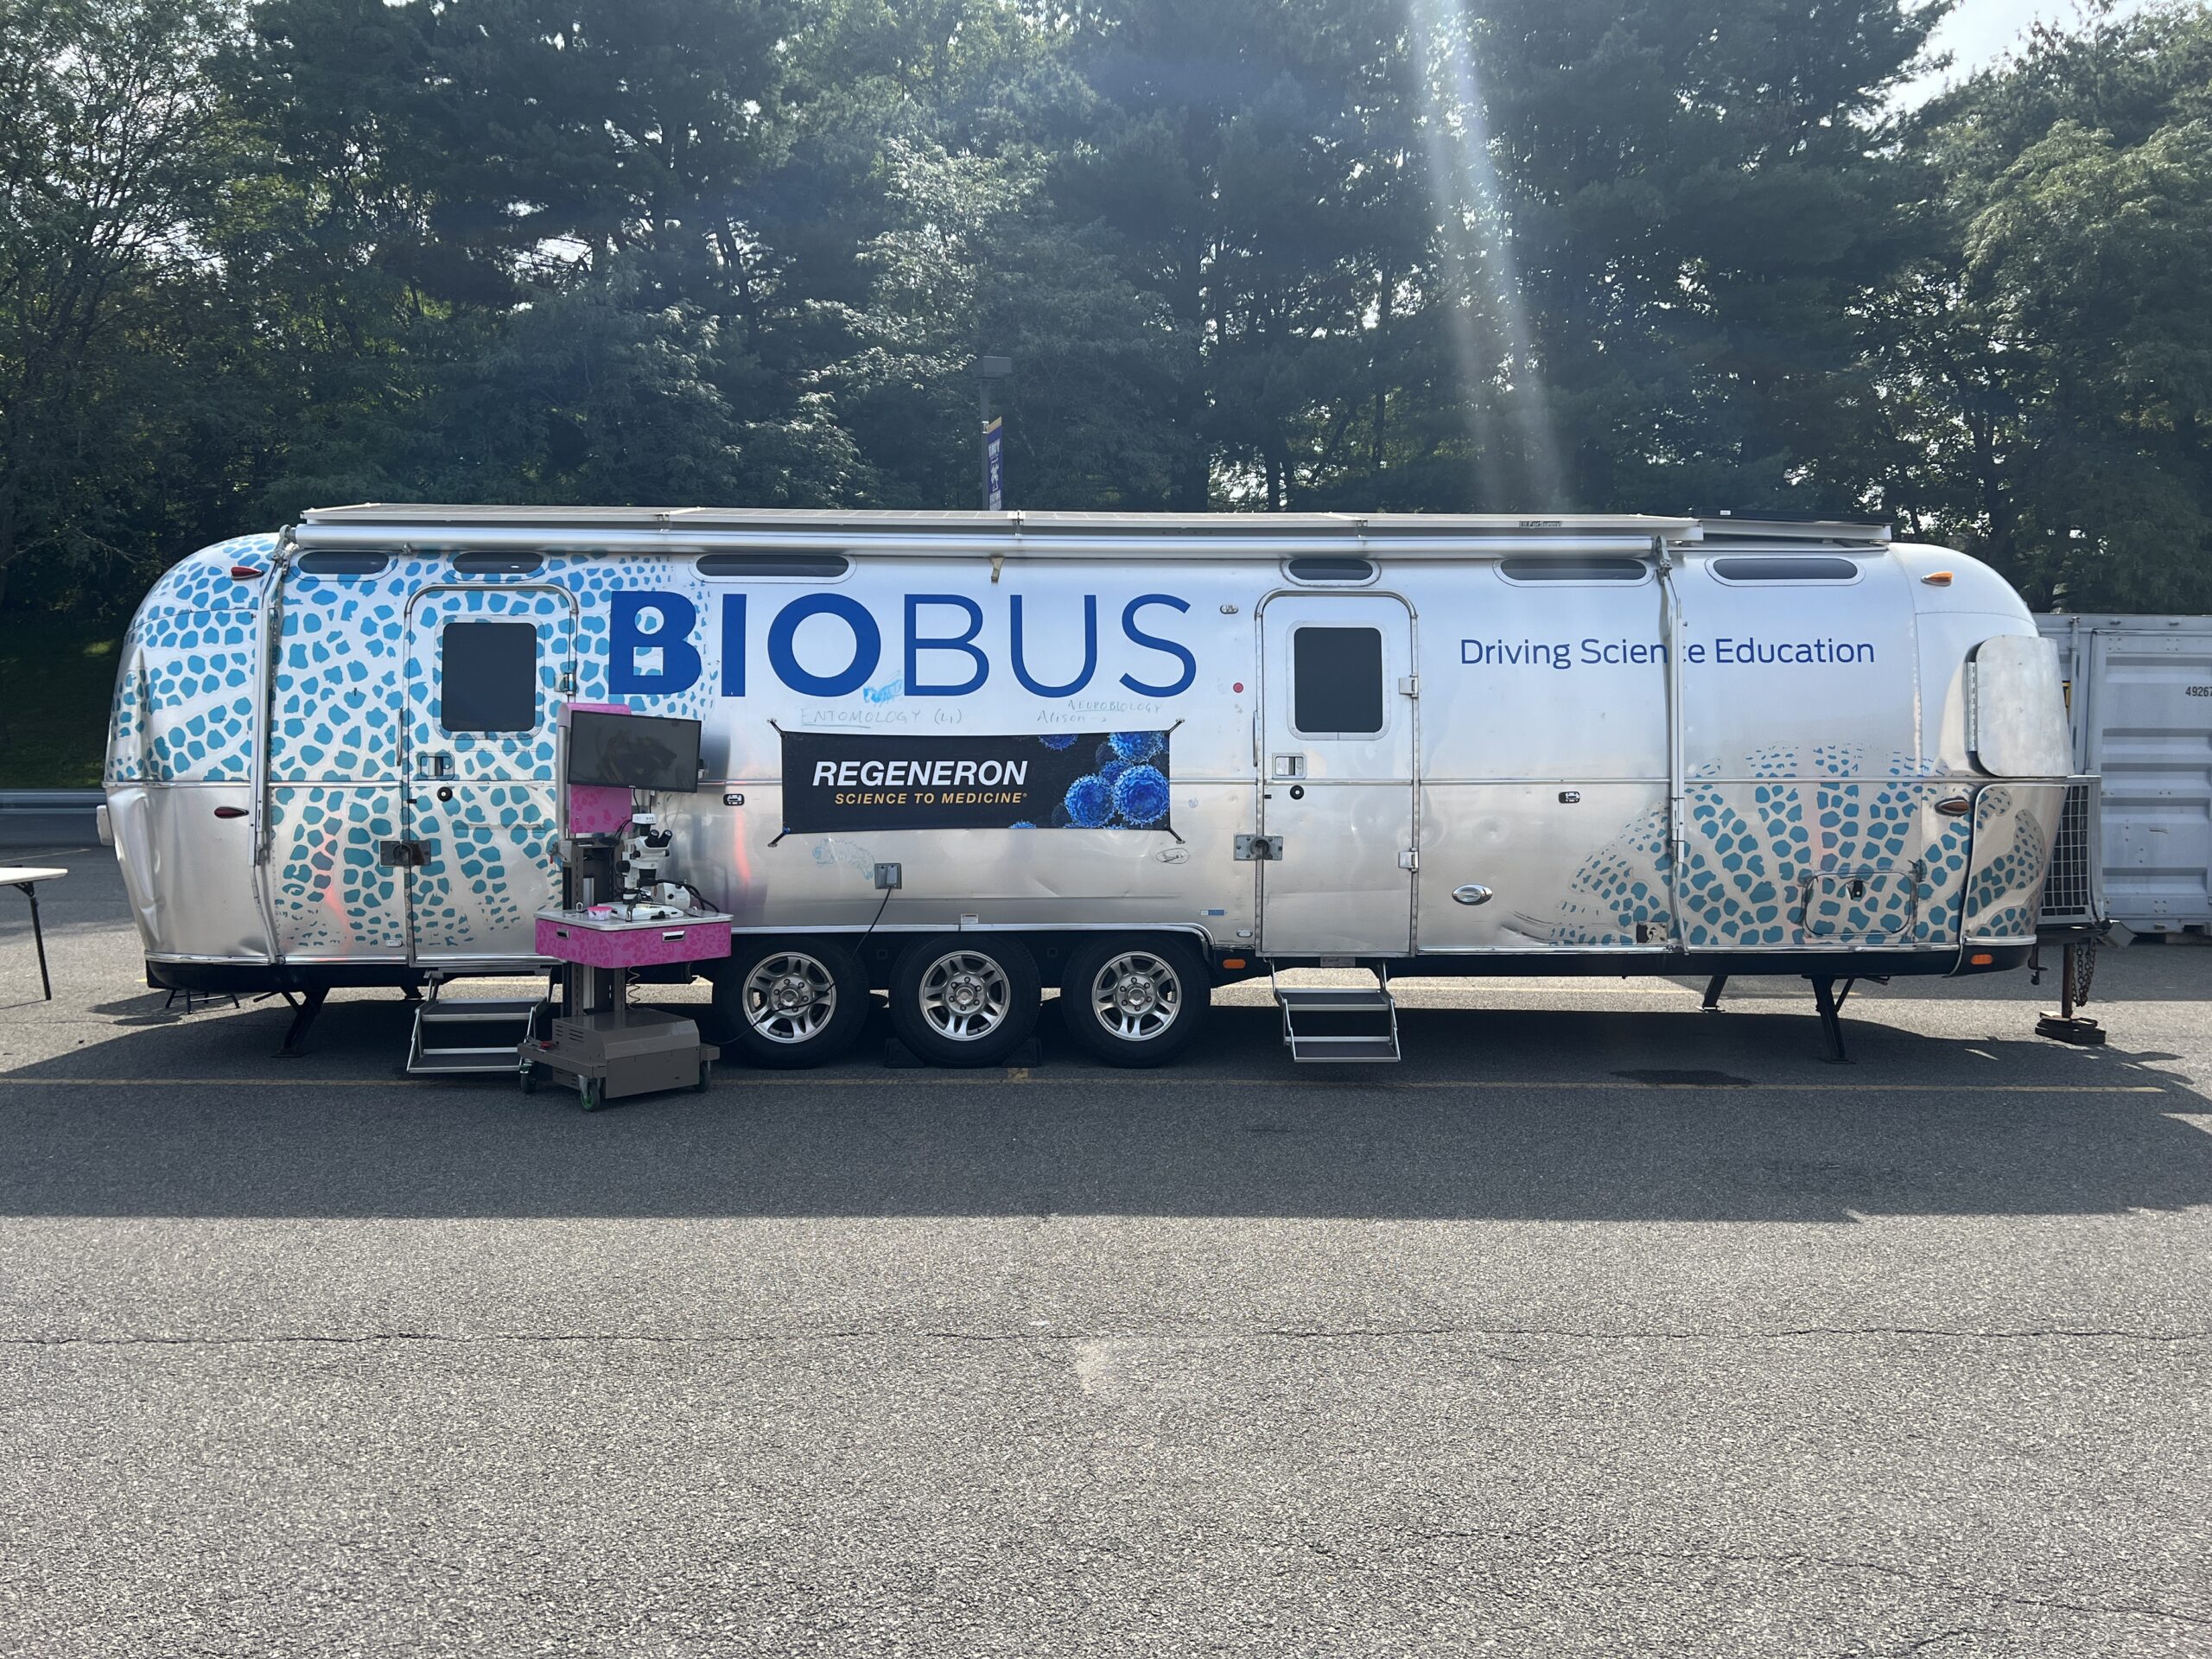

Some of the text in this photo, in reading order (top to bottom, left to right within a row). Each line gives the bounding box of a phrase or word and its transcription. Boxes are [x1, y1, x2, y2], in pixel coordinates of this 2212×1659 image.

[608, 590, 1198, 697] BIOBUS
[1460, 638, 1875, 670] Driving Sciene Education
[800, 708, 921, 726] ENTOMOLOGY
[1037, 710, 1085, 723] Alison
[812, 760, 1028, 786] REGENERON
[835, 793, 907, 804] SCIENCE
[914, 793, 935, 804] TO
